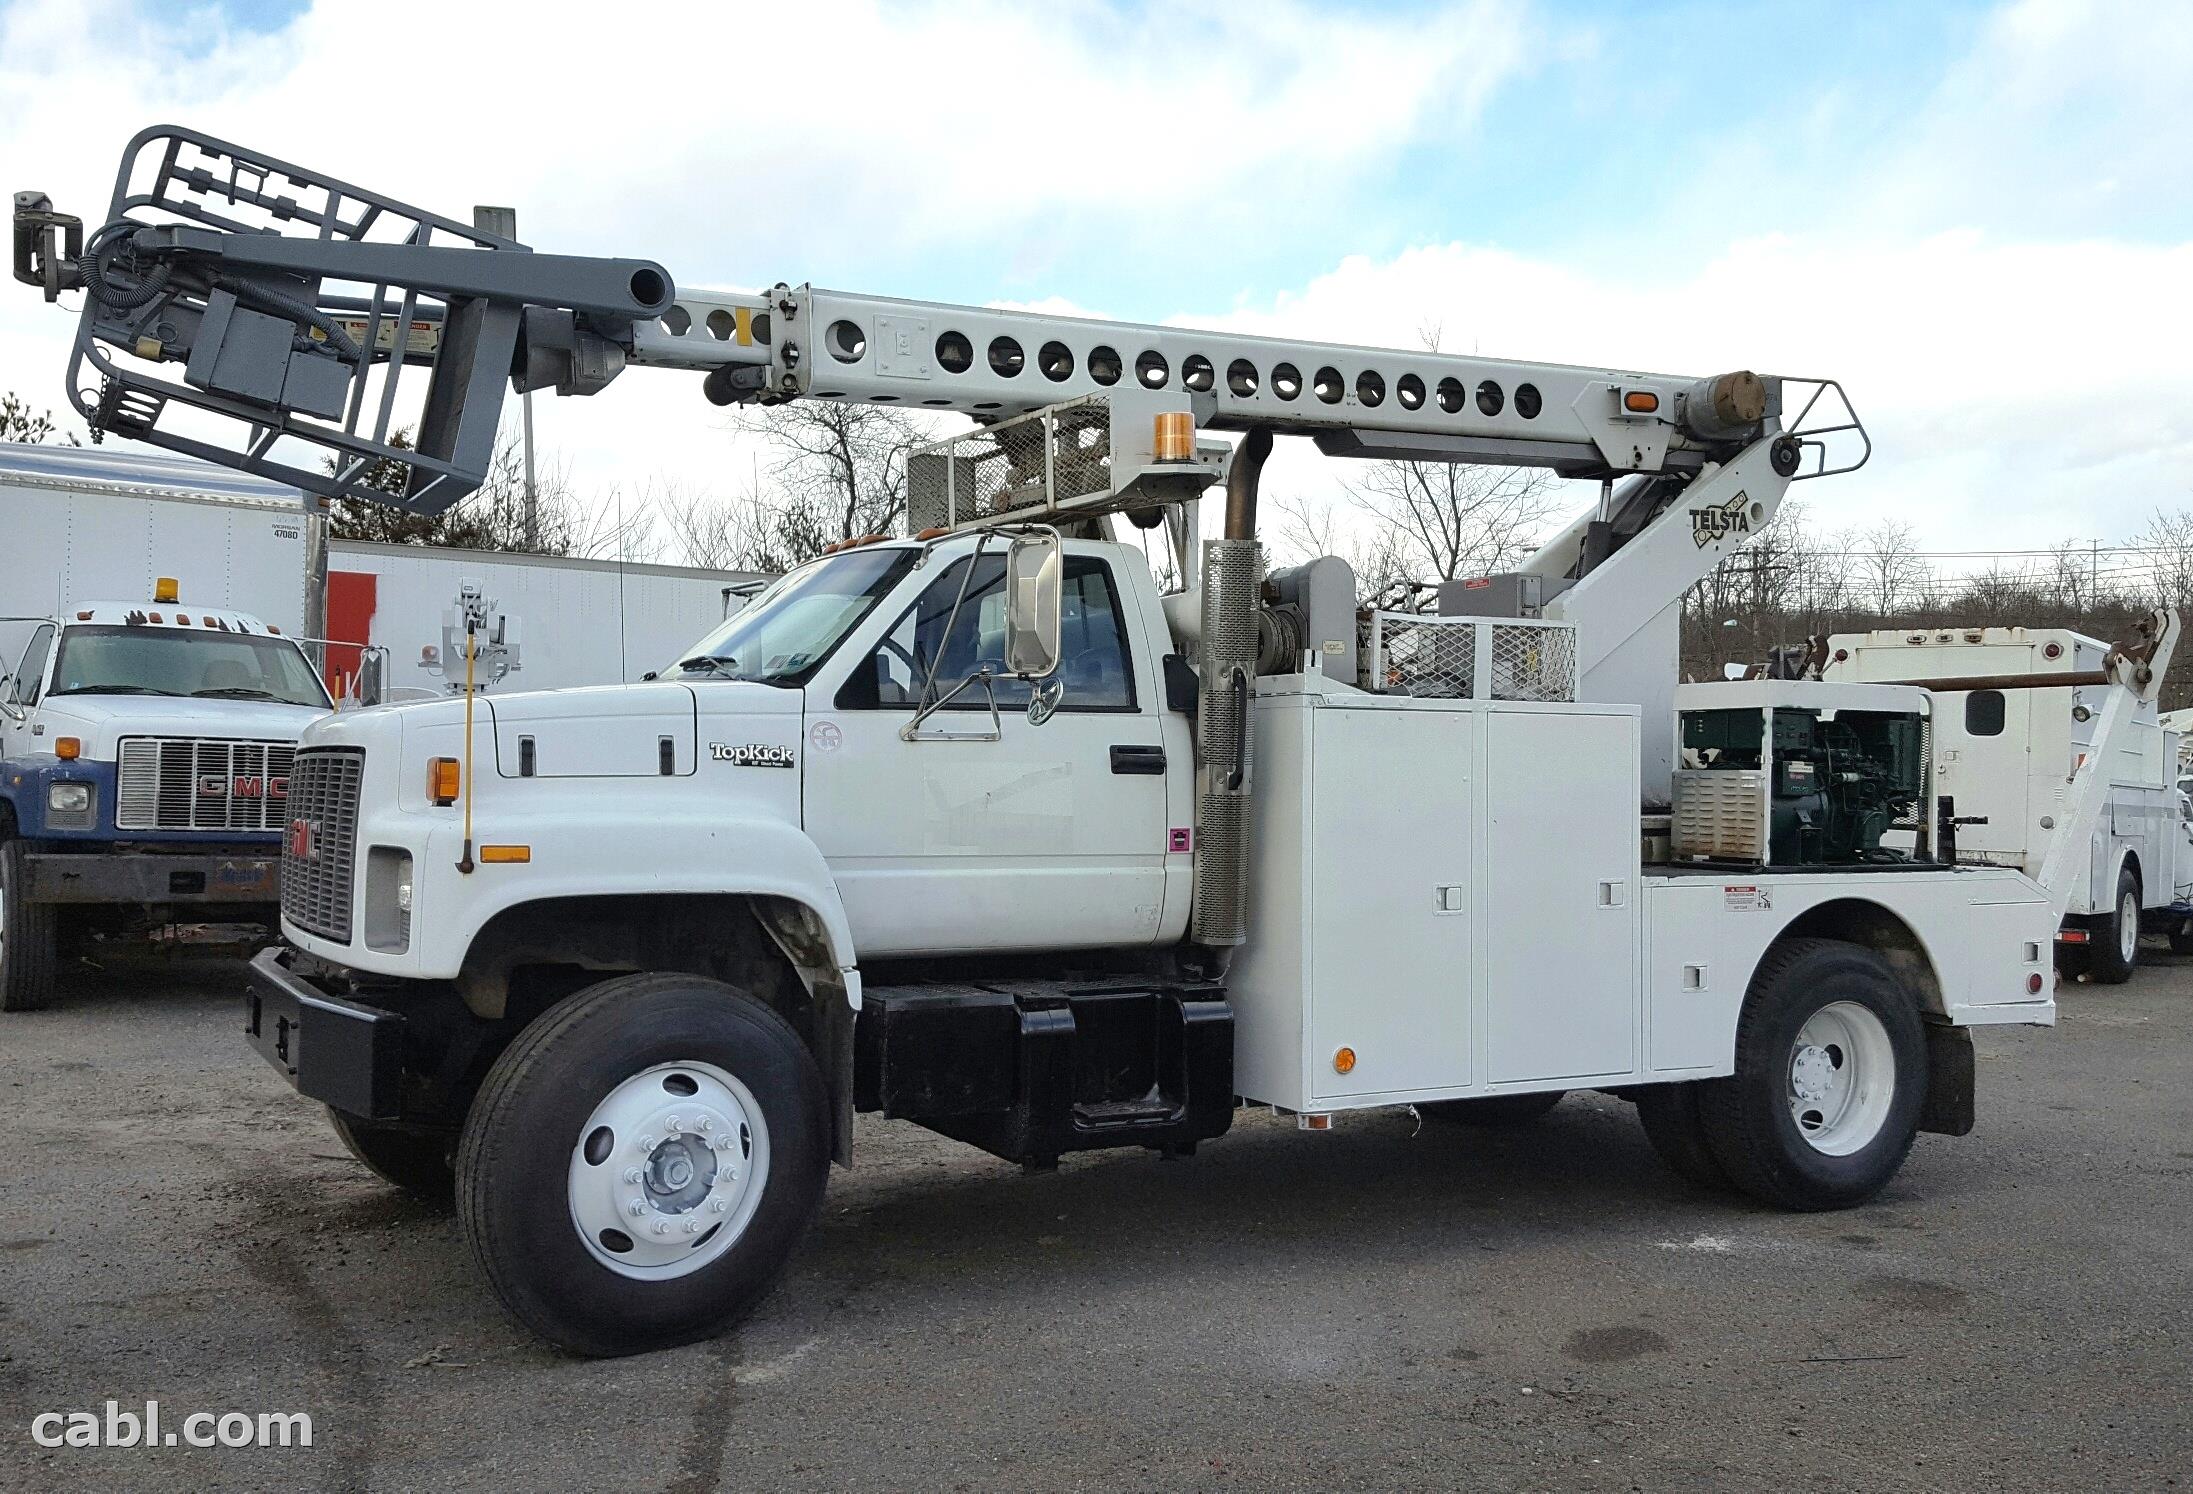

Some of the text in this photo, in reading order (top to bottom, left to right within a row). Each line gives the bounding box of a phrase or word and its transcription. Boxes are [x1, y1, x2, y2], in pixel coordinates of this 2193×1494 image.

[1689, 509, 1749, 532] TELSTA
[709, 742, 794, 765] TopKick
[200, 775, 291, 798] GMC
